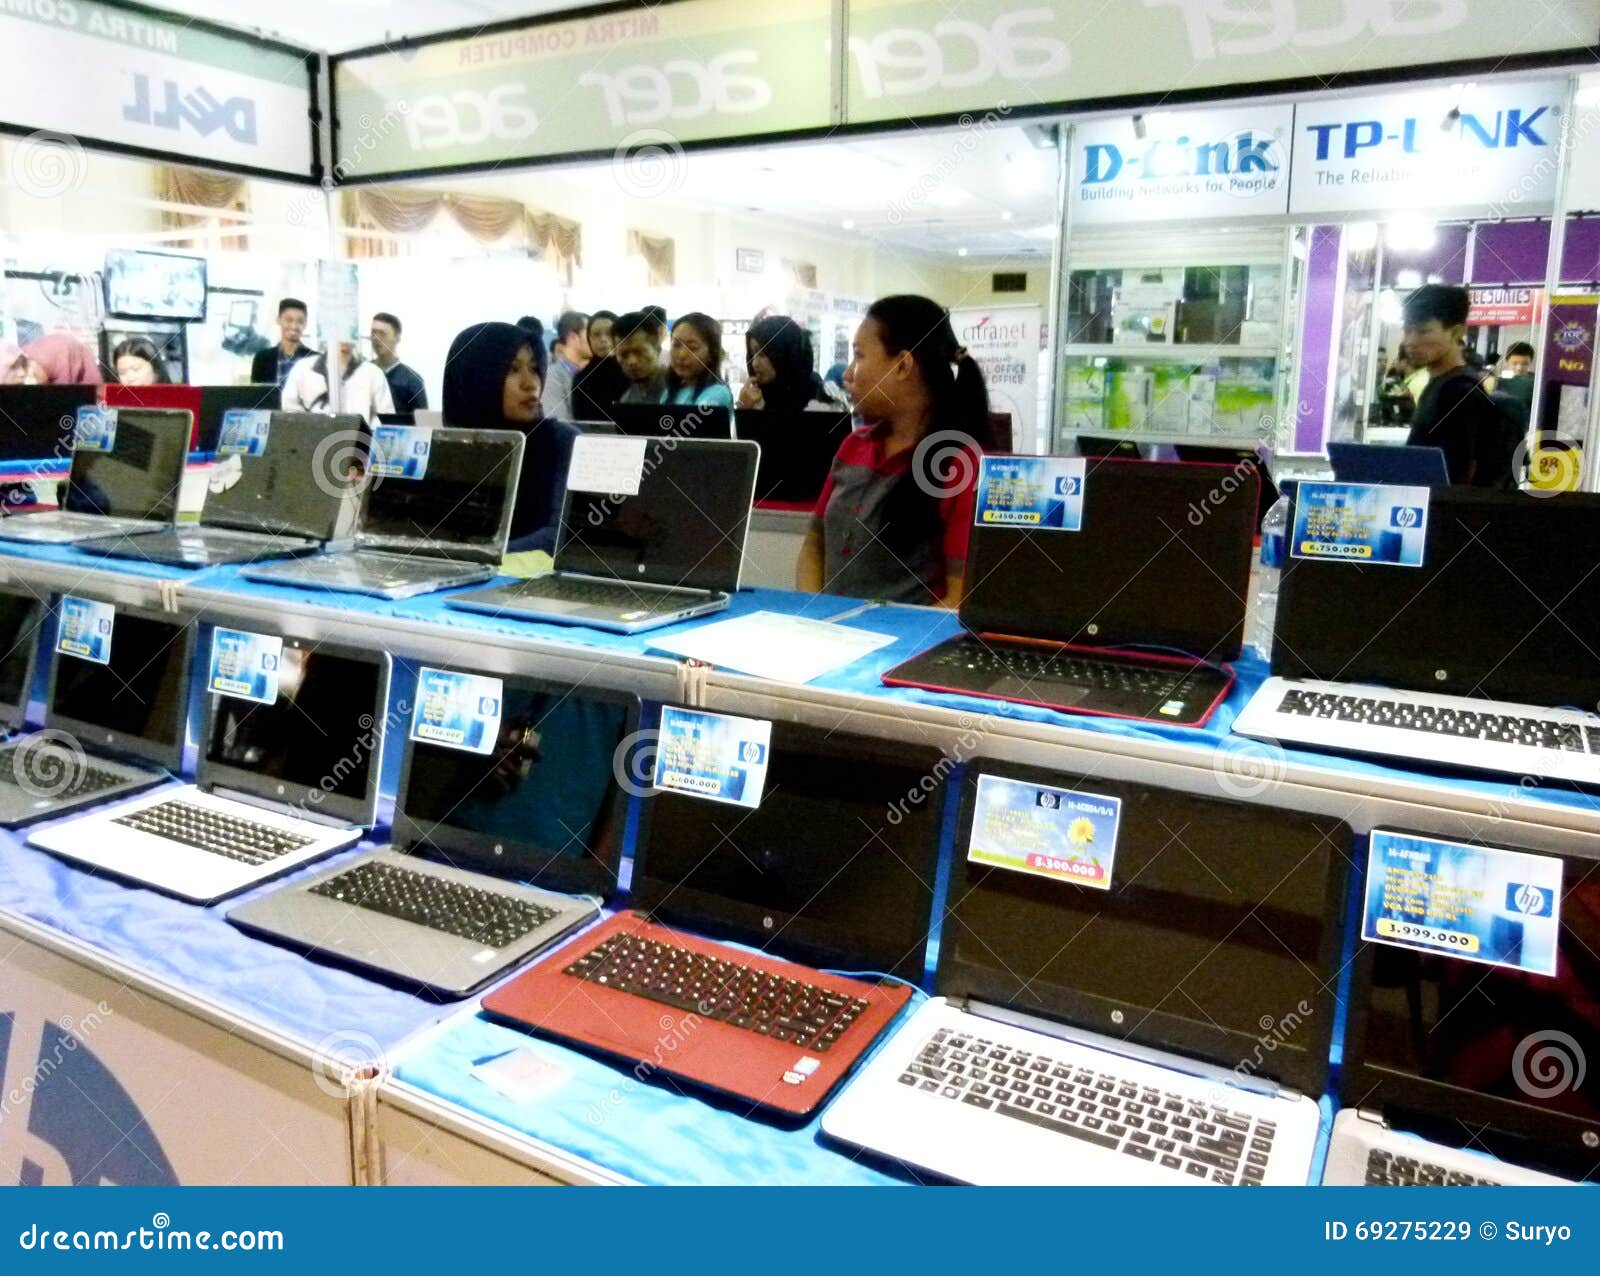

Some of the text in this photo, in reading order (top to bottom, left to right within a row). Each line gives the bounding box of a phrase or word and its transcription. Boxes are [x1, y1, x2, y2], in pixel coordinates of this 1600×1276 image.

[1306, 105, 1549, 161] TP-LNK
[1081, 186, 1134, 202] Building
[1205, 179, 1224, 192] for
[1230, 177, 1276, 195] People
[1316, 170, 1345, 186] The
[1388, 923, 1470, 947] 3.999.000
